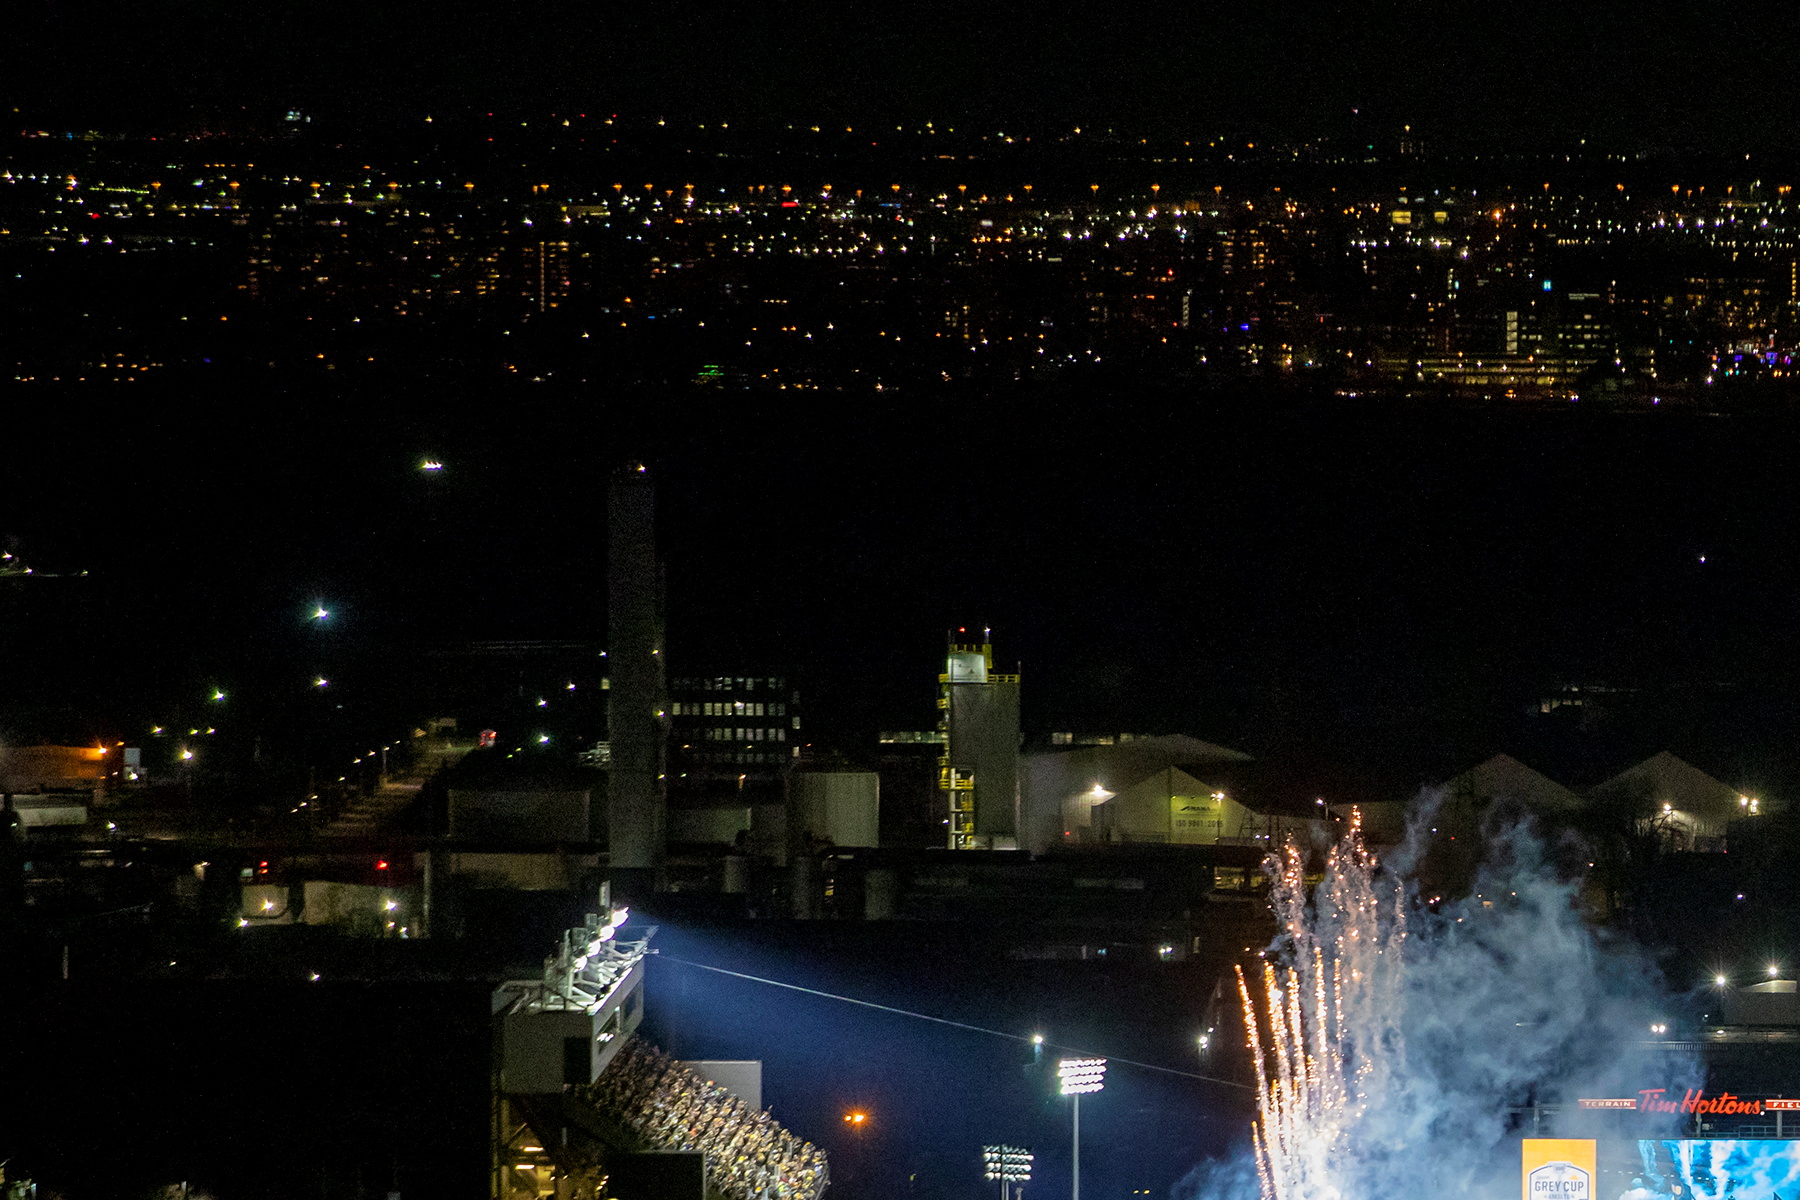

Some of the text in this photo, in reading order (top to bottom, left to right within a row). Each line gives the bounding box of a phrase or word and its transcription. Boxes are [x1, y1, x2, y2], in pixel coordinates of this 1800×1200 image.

[1584, 1100, 1631, 1108] TERRAIN
[1638, 1088, 1677, 1114] Tim
[1679, 1088, 1761, 1115] Hortons
[1534, 1181, 1585, 1192] GREY CUP
